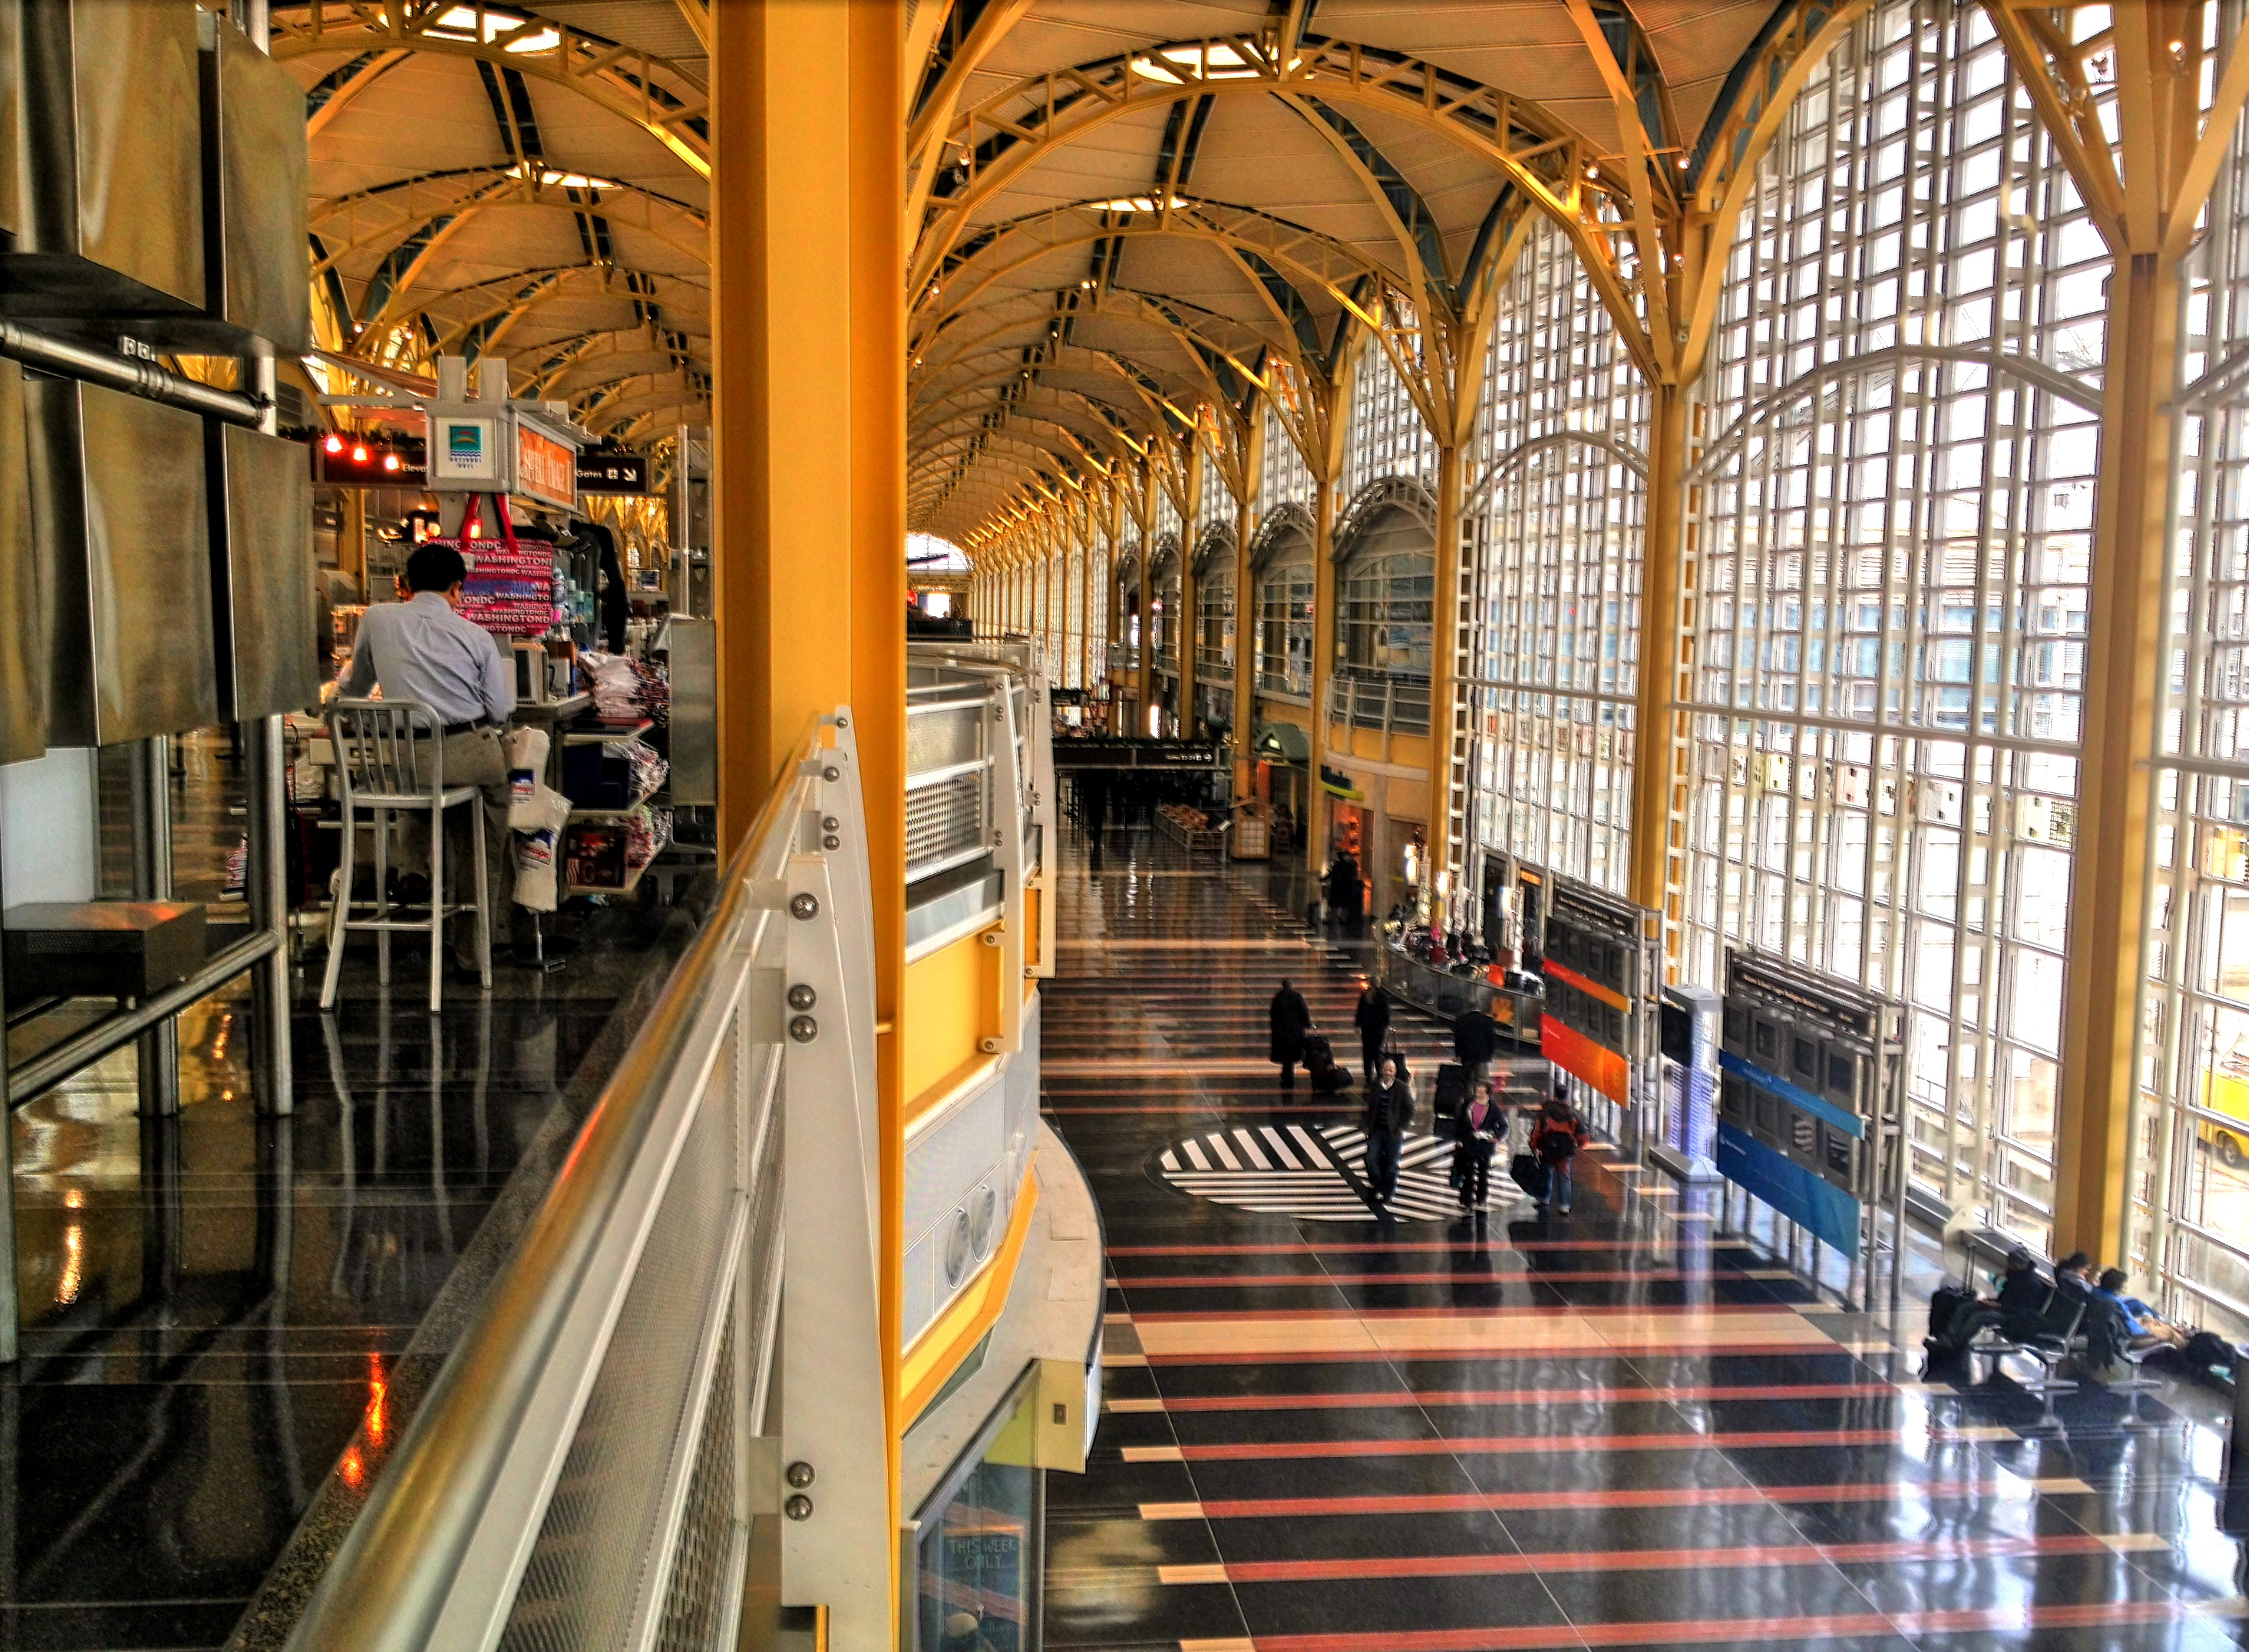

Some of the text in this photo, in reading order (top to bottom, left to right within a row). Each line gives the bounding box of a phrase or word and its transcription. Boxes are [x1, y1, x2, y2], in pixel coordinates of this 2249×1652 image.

[951, 1538, 1017, 1554] THIS WEEK
[966, 1554, 1003, 1570] OLY
